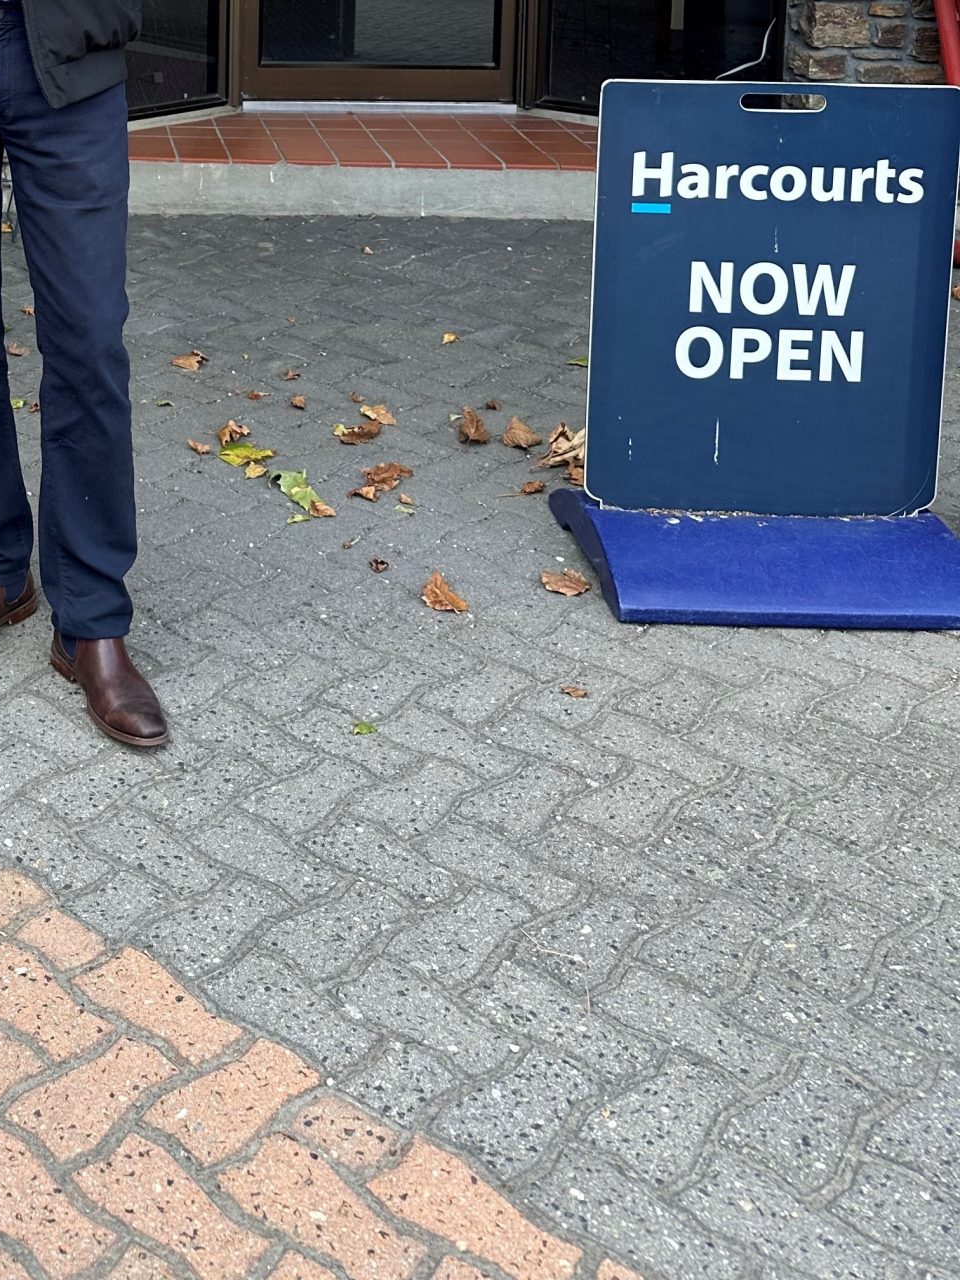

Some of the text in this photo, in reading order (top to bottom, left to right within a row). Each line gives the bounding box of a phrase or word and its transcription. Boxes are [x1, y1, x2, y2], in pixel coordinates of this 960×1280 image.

[632, 151, 925, 204] Harcourts
[689, 261, 856, 316] NOW
[675, 326, 865, 382] OPEN
